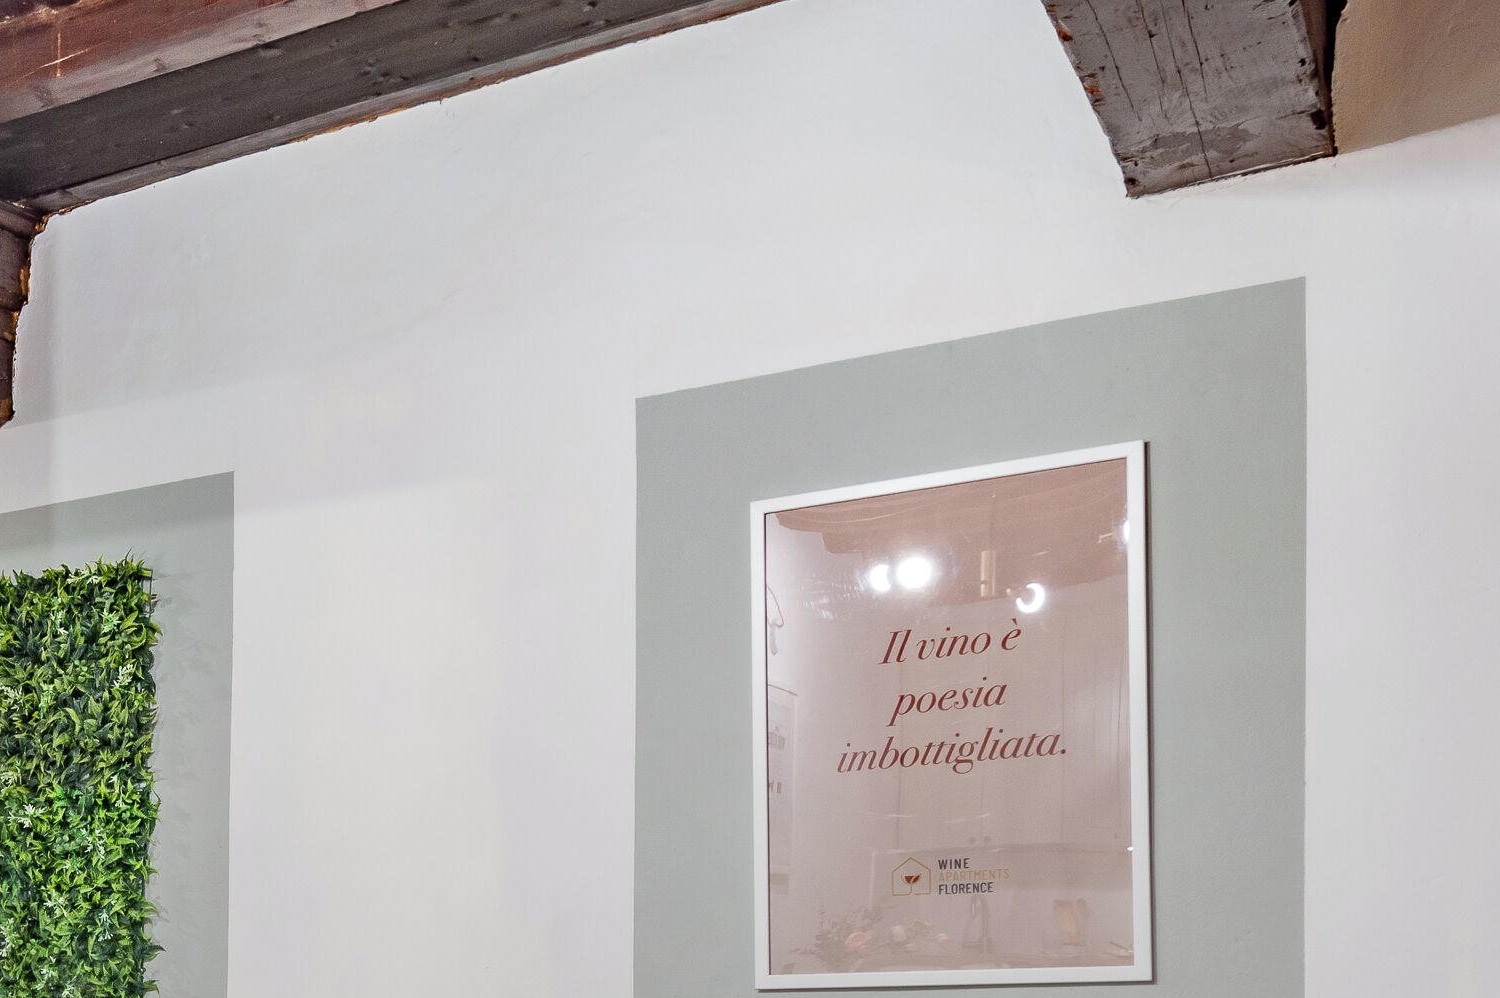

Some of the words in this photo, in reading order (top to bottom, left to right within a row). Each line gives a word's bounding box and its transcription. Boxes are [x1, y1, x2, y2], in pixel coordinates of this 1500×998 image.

[878, 629, 912, 665] Il
[916, 627, 992, 661] vino
[1000, 618, 1022, 651] è
[886, 676, 1007, 727] poesia
[836, 727, 1067, 775] imbottigliata.
[938, 858, 970, 870] WINE
[939, 868, 1010, 881] APARTMENTS
[938, 882, 994, 895] FLORENCE
